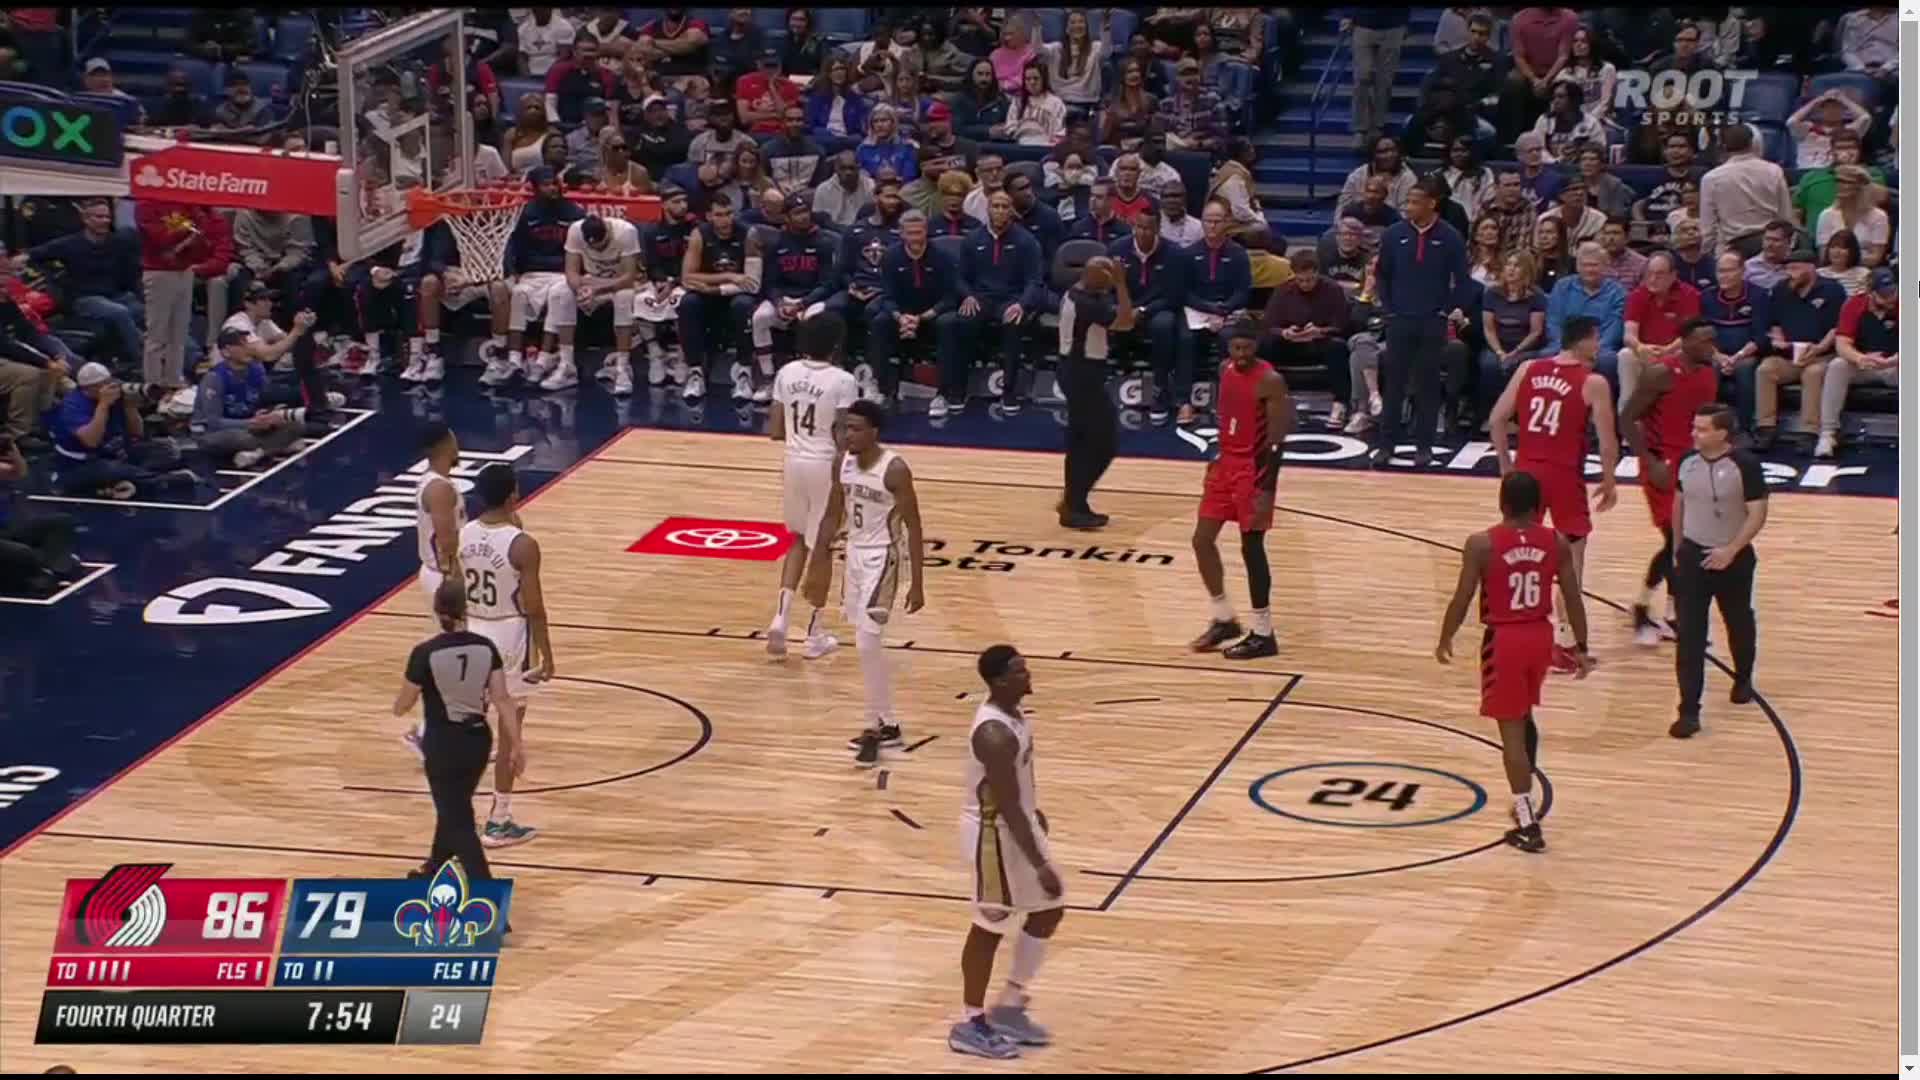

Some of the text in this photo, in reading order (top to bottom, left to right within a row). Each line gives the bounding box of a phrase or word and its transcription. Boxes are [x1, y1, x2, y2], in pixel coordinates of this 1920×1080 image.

[790, 400, 817, 436] 14
[1527, 396, 1563, 436] 24
[853, 502, 864, 529] 5
[971, 539, 1176, 566] Tonkin
[465, 568, 498, 607] 25
[1508, 570, 1541, 611] 26
[456, 653, 469, 681] 7
[1306, 777, 1422, 812] 24
